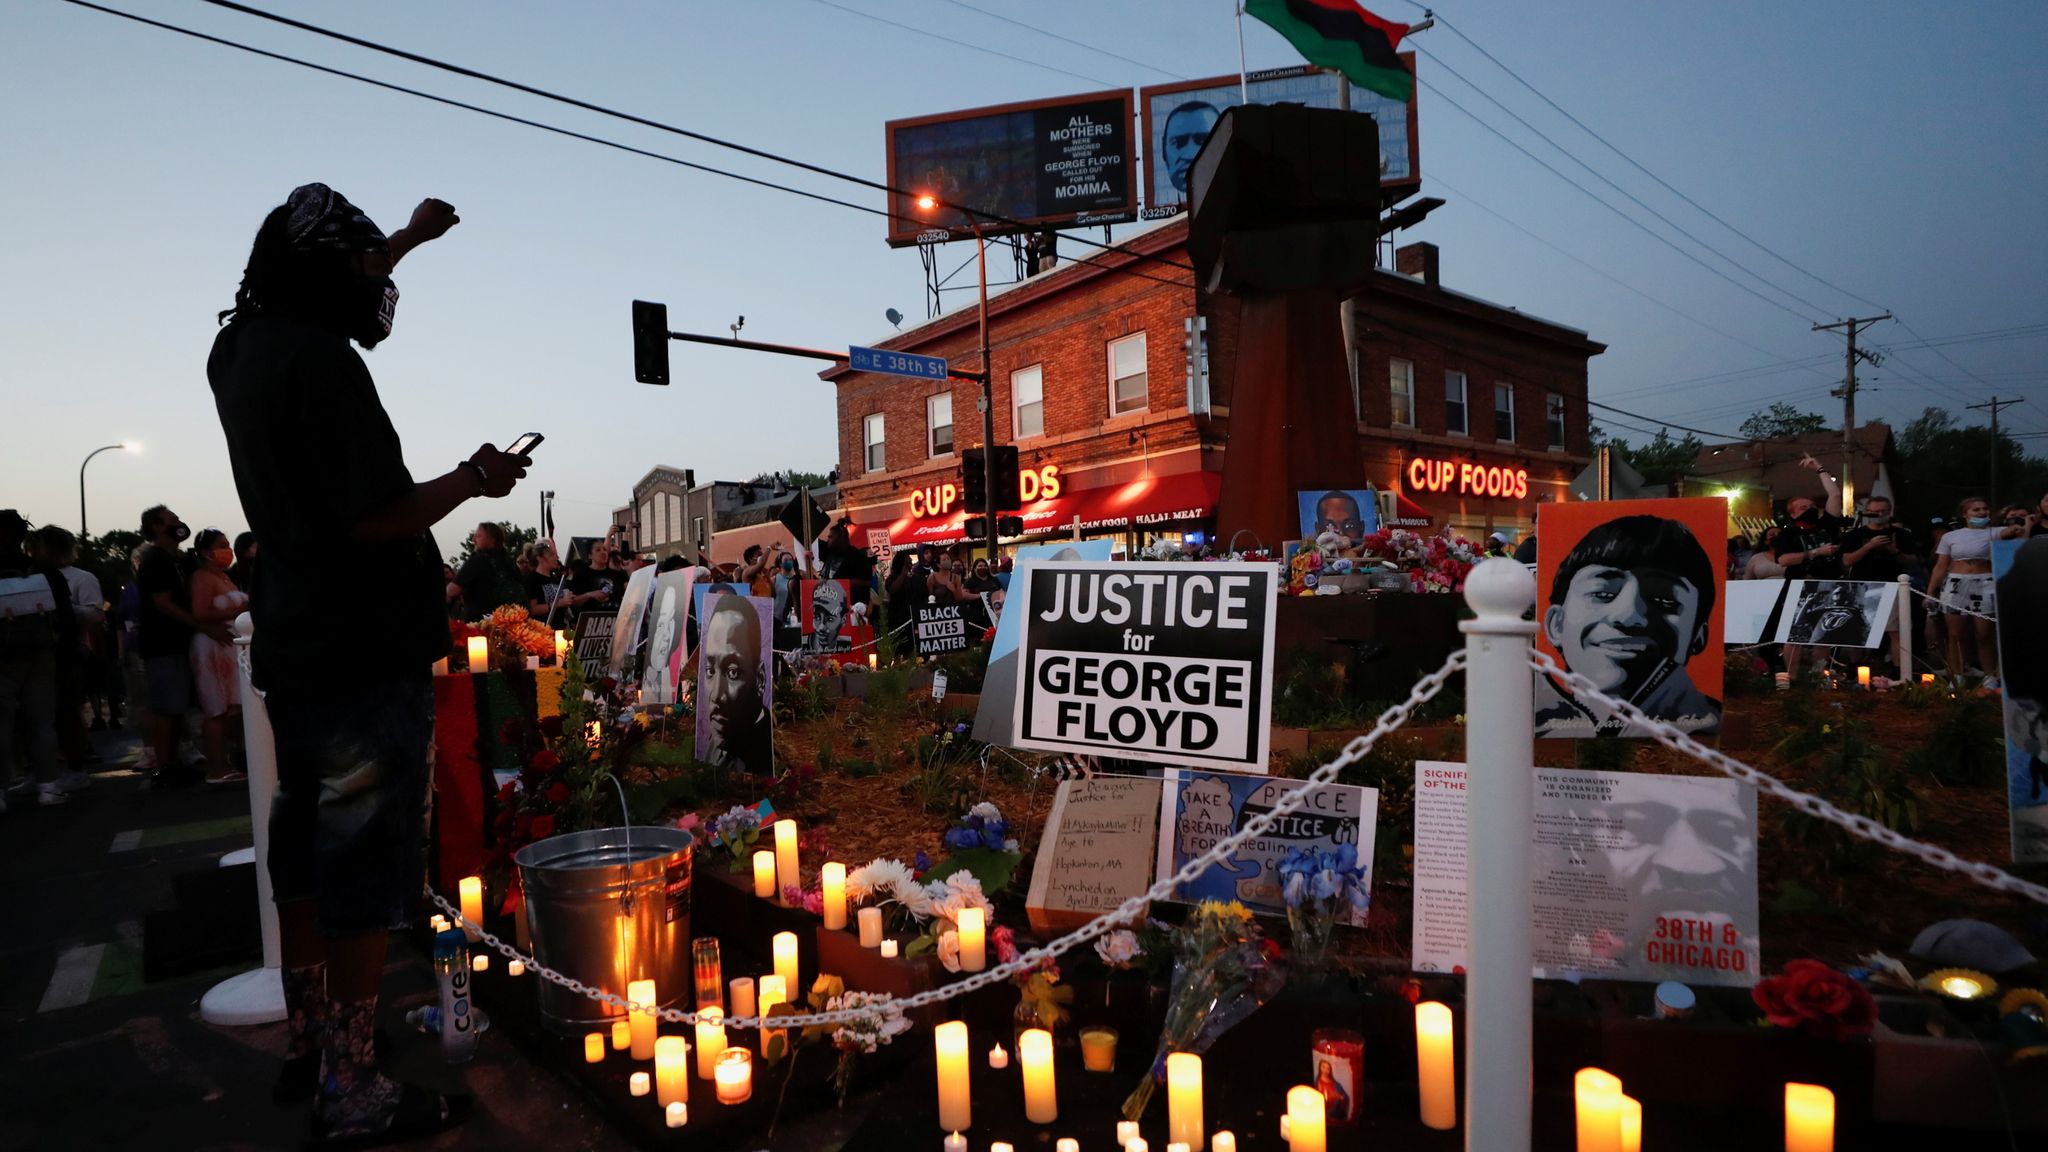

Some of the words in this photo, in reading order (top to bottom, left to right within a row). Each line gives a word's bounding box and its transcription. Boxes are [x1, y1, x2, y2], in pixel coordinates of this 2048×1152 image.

[1068, 115, 1093, 128] ALL
[1050, 123, 1113, 142] MOTHERS
[1063, 143, 1101, 153] SUMMONED
[1072, 137, 1091, 145] WERE
[1072, 150, 1092, 158] WHEN
[1044, 158, 1086, 172] GEORGE
[1088, 155, 1121, 166] FLOYD
[1062, 167, 1088, 177] CALLED
[1055, 181, 1111, 199] MOMMA
[1141, 206, 1177, 218] 032570
[916, 230, 950, 243] 032540
[872, 354, 882, 368] E
[888, 356, 923, 374] 38th
[928, 361, 944, 376] St
[1410, 457, 1455, 493] CUP
[1460, 463, 1528, 500] FOODS
[910, 483, 956, 519] CUP
[1058, 520, 1101, 531] MEXCAN
[1101, 517, 1129, 527] FOOD
[1135, 513, 1171, 524] HALAL
[1172, 508, 1203, 520] MEAT
[872, 545, 890, 557] 25
[1039, 573, 1250, 629] JUSTICE
[919, 605, 961, 621] BLACK
[924, 621, 958, 637] LIVES
[919, 636, 967, 653] MATTER
[1123, 628, 1155, 651] for
[580, 638, 610, 659] LIVES
[1038, 655, 1244, 708] GEORGE
[1056, 700, 1218, 750] FLOYD
[1423, 780, 1440, 788] OF
[1443, 781, 1467, 790] THE
[1558, 784, 1612, 793] ORGANIZED
[1561, 776, 1620, 786] COMMUNITY
[1069, 789, 1106, 804] Justice
[1185, 791, 1222, 806] TAKE
[1564, 792, 1598, 800] TENDED
[1200, 808, 1211, 819] A
[1244, 811, 1324, 836] STICE
[1061, 837, 1077, 850] Age
[1191, 837, 1217, 850] FOR
[1106, 859, 1122, 869] MA
[1052, 877, 1102, 897] Lynched
[1104, 886, 1117, 895] on
[1066, 894, 1088, 912] April
[1655, 916, 1713, 943] 38TH
[1722, 923, 1737, 946] &
[1647, 941, 1745, 972] CHICAGO
[452, 972, 471, 1032] core
